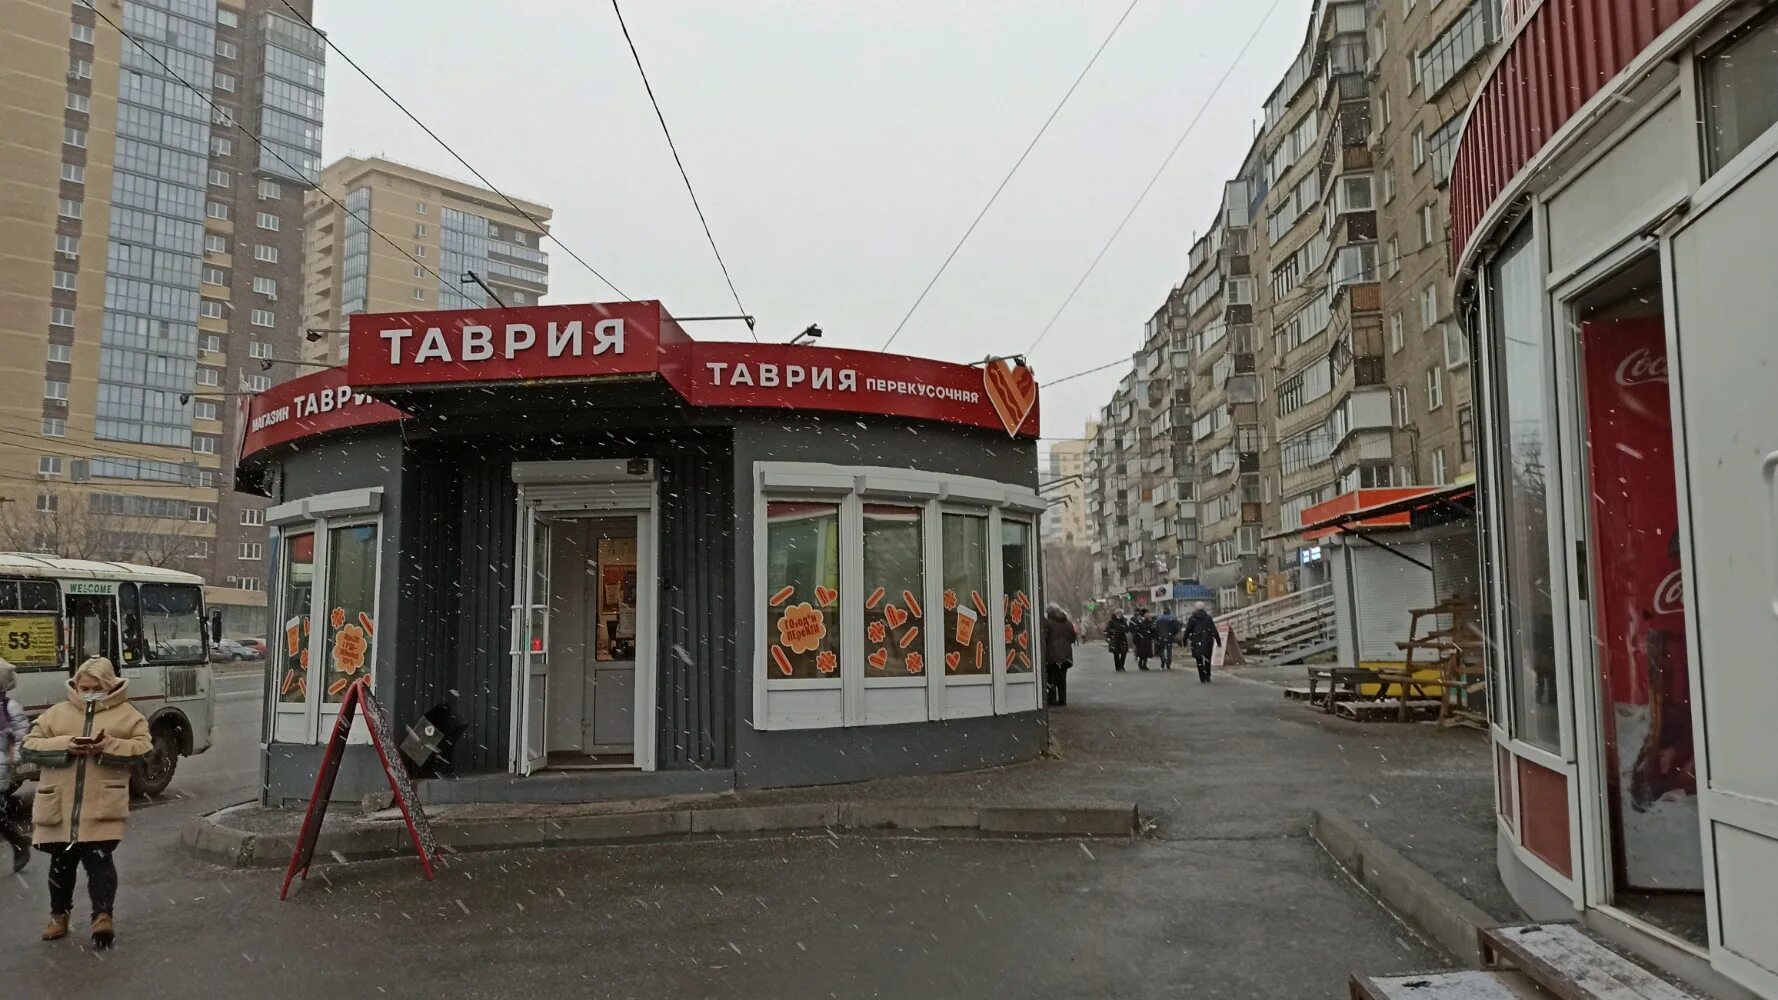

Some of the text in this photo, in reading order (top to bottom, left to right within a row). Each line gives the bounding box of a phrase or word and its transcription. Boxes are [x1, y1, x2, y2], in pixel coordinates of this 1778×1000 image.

[379, 318, 626, 365] ТАВРИЯ
[706, 362, 979, 404] ТАВРИЯ ПЕРЕКУСОЧНАЯ
[252, 405, 290, 433] МАГАЗИН
[70, 584, 112, 593] WELCOME
[8, 631, 31, 650] 53
